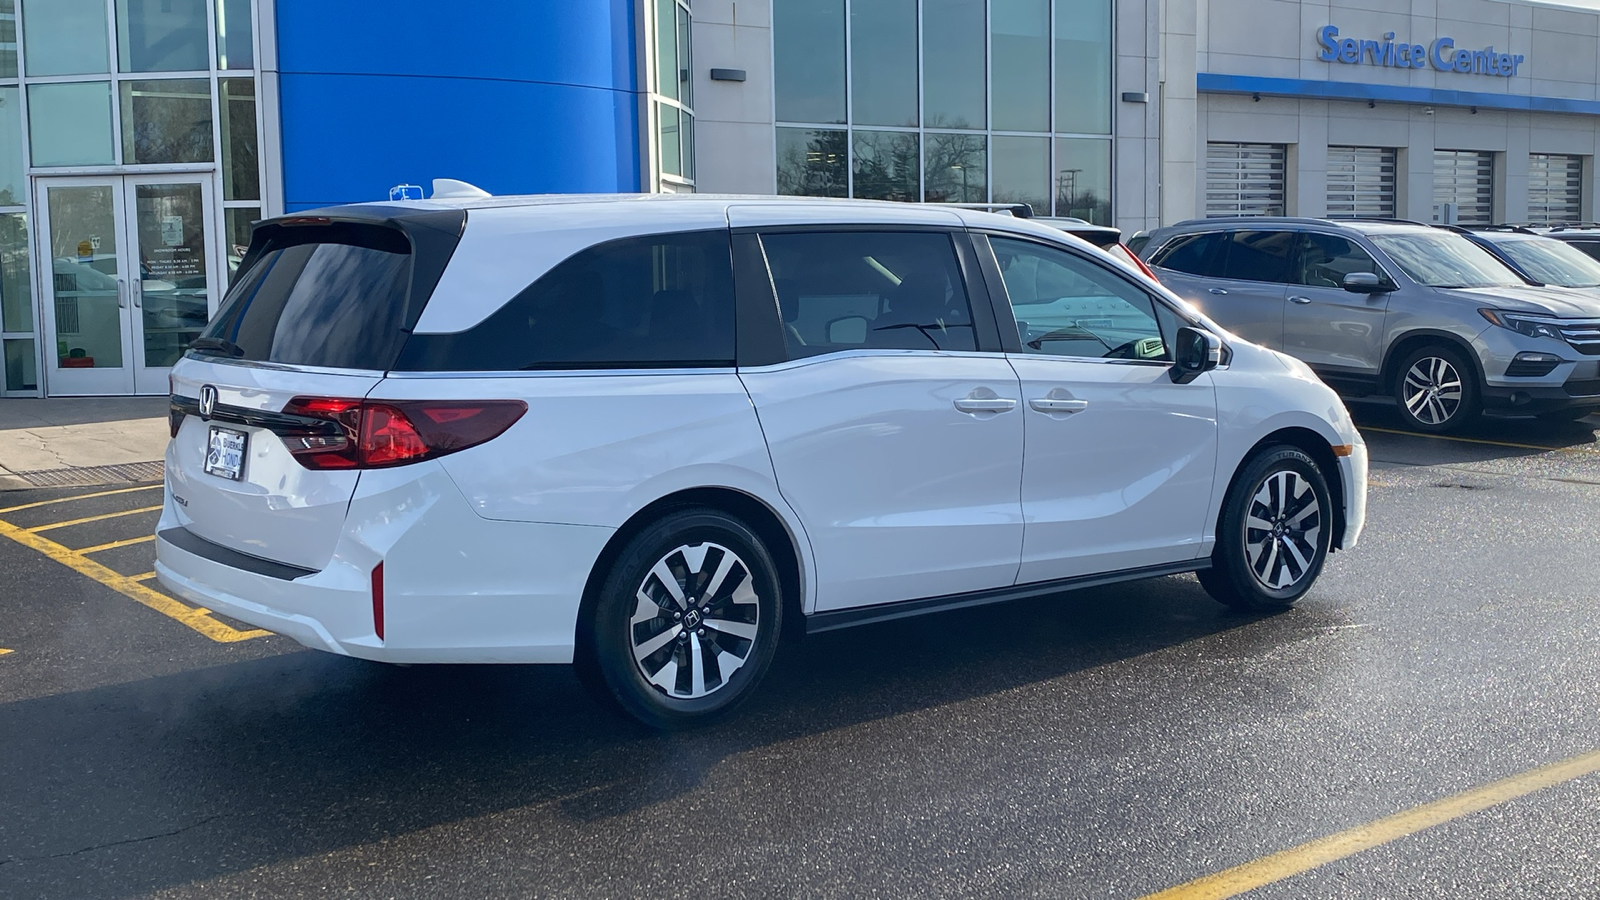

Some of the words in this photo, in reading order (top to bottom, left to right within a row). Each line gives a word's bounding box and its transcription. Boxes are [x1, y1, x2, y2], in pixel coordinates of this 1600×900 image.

[1317, 25, 1426, 70] Service
[1429, 37, 1524, 77] Center
[222, 437, 244, 452] BUERKLE
